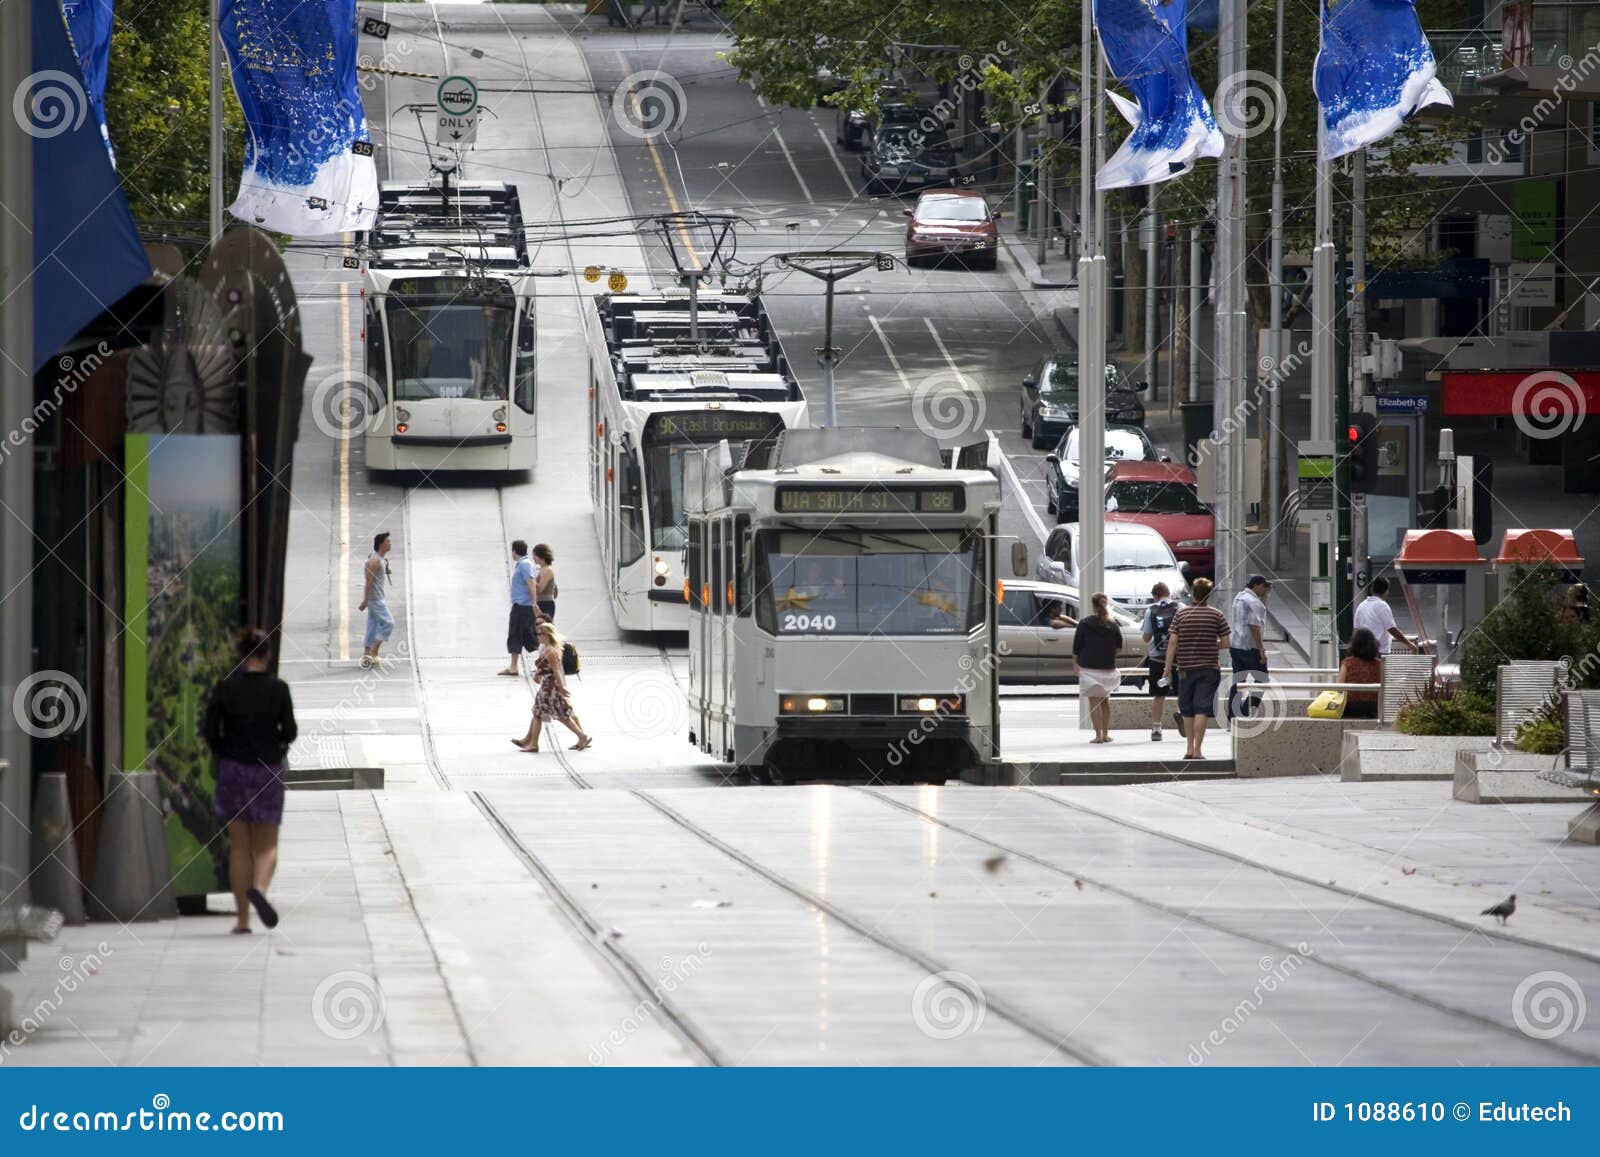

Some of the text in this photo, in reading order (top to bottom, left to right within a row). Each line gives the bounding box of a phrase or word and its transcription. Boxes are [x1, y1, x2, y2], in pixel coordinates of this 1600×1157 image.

[366, 21, 387, 36] 36
[439, 118, 475, 129] ONLY
[354, 143, 371, 155] 35
[962, 175, 976, 185] 34
[973, 241, 986, 250] 32
[344, 258, 359, 269] 33
[610, 282, 626, 290] OFF
[1378, 398, 1428, 408] Elizabeth St
[660, 416, 677, 435] 96
[682, 416, 707, 432] East
[782, 491, 810, 511] VIA
[871, 492, 889, 510] ST
[931, 492, 951, 508] 86
[784, 614, 837, 631] 2040
